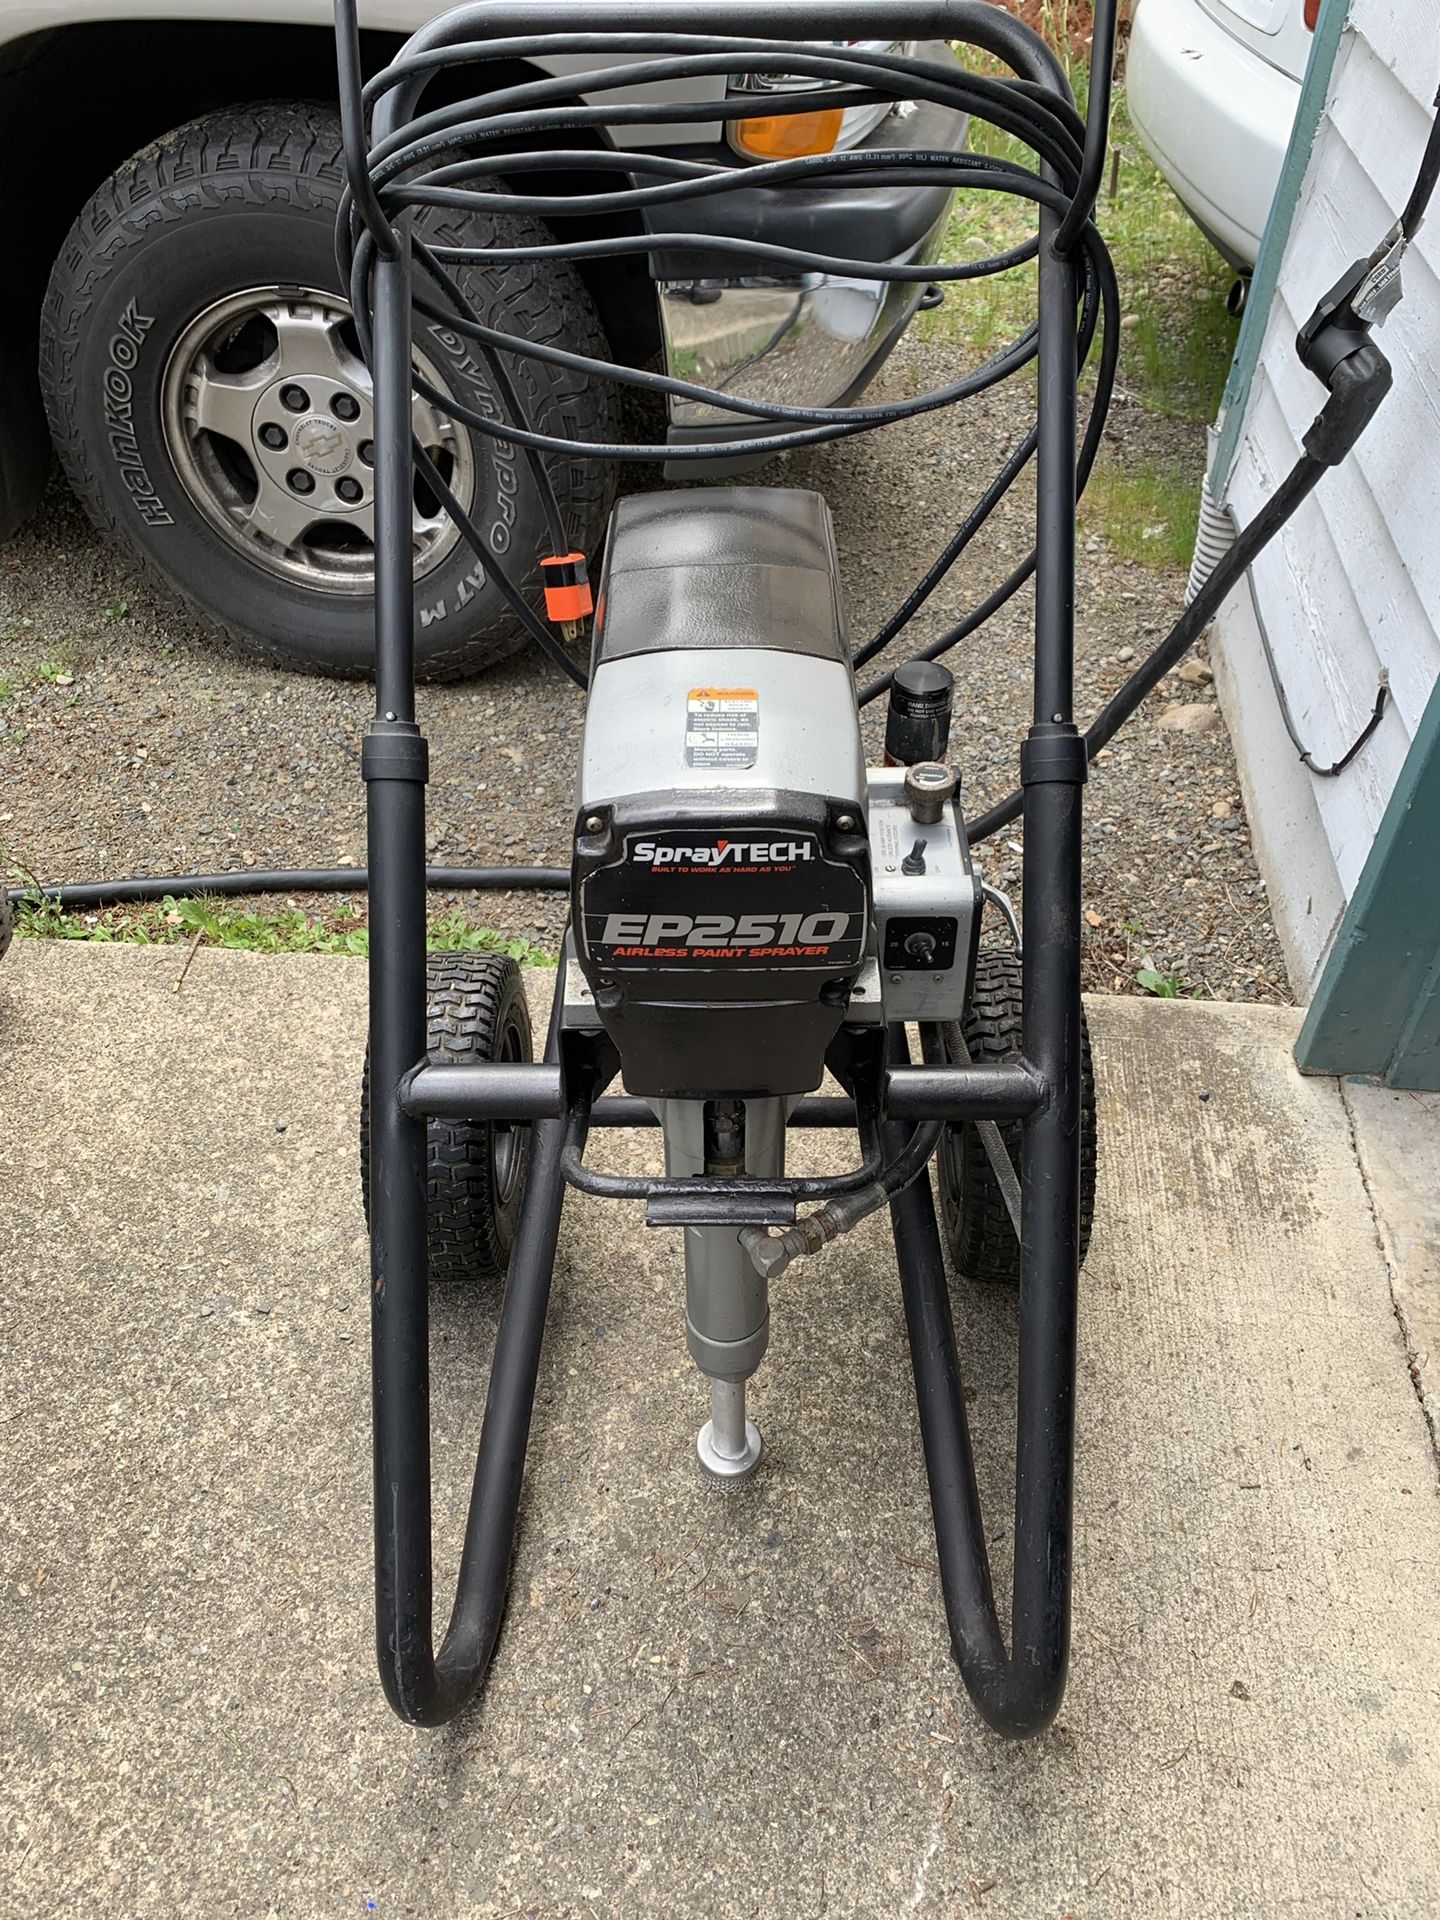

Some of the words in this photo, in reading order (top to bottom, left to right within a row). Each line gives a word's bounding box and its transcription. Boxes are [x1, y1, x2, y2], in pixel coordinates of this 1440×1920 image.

[503, 126, 536, 136] RESISTANT
[952, 157, 982, 168] RESISTANT
[1372, 268, 1386, 284] CORD
[314, 420, 337, 431] TRUCKS
[308, 462, 330, 474] TRUCKS
[602, 912, 850, 946] EP2510
[612, 947, 688, 957] AIRLESS
[692, 947, 744, 958] PAINT
[748, 946, 830, 957] SPRAYER
